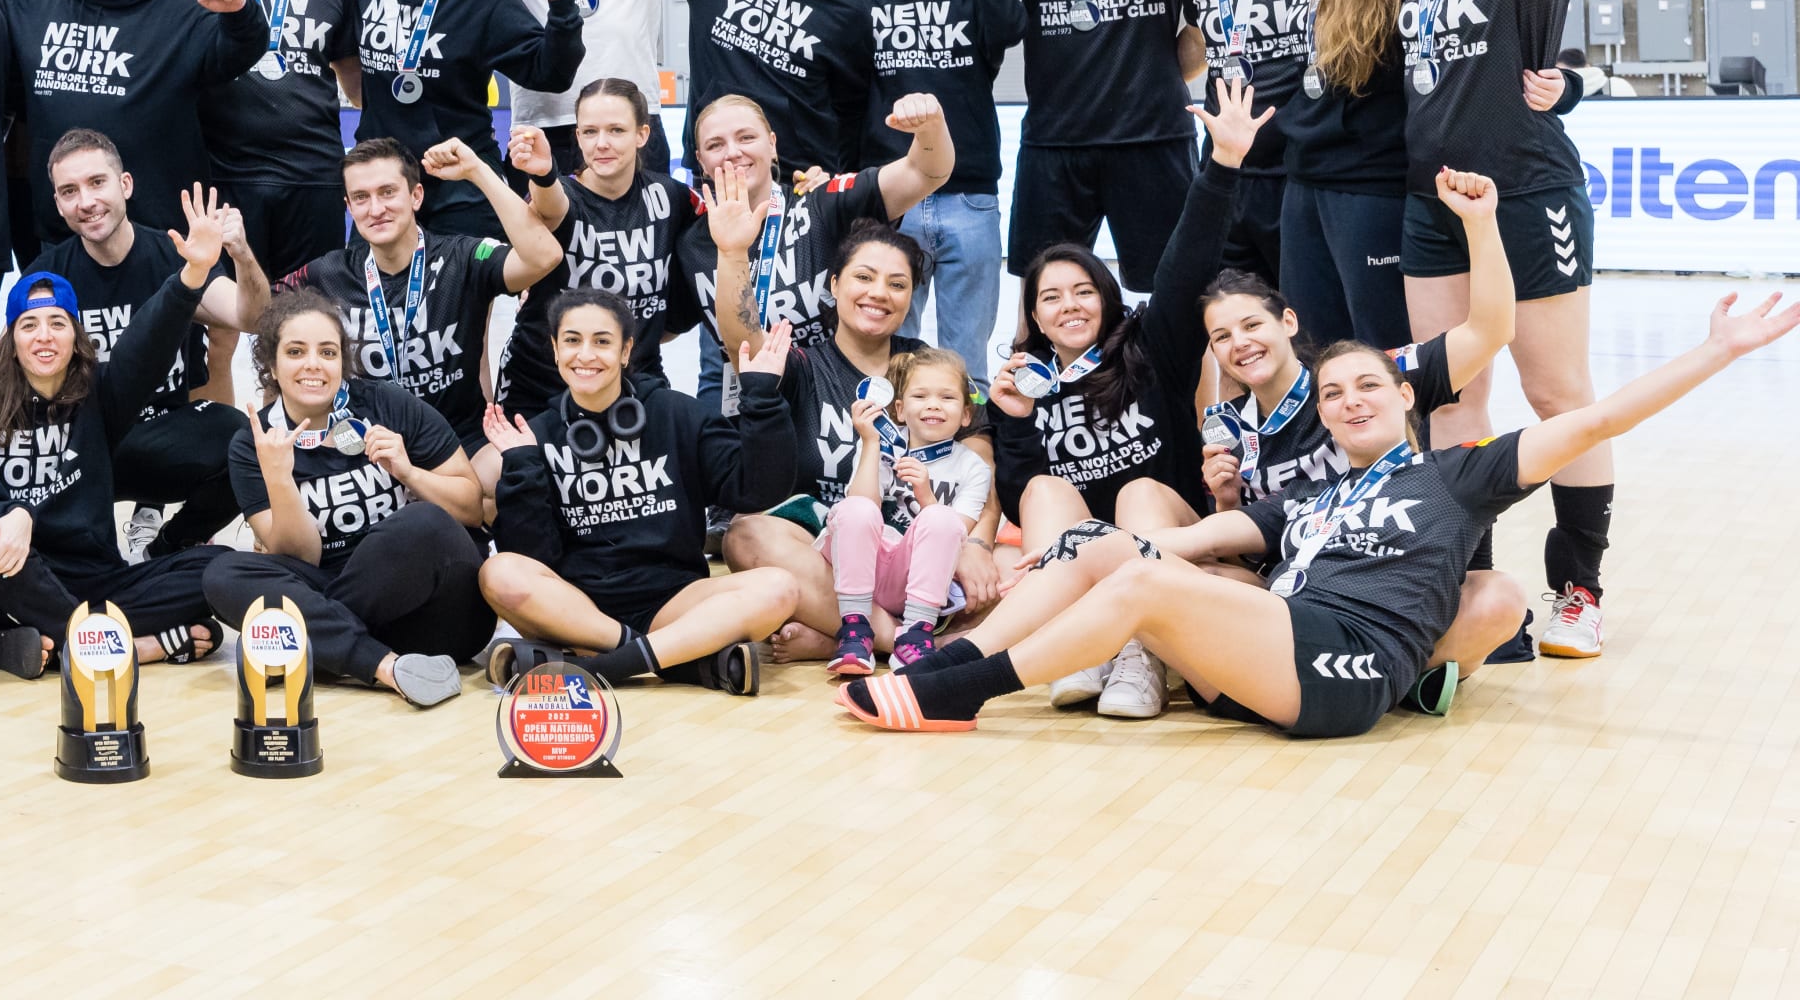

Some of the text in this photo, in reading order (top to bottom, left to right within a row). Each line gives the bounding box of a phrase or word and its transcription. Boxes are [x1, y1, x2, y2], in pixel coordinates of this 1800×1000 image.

[871, 1, 950, 28] NEW
[1040, 2, 1068, 13] THE
[1127, 2, 1165, 18] CLUB
[43, 22, 119, 49] NEW
[714, 17, 790, 62] THE WORLD'S
[873, 21, 972, 50] YORK
[1042, 28, 1056, 36] since
[1232, 32, 1240, 46] USA
[712, 25, 807, 78] HANDBALL CLUB
[874, 50, 952, 60] THE WORLD'S
[1444, 40, 1488, 61] CLUB
[40, 45, 134, 77] YORK
[939, 56, 973, 69] CLUB
[36, 70, 107, 85] THE WORLD'S
[35, 80, 126, 96] HANDBALL CLUB
[642, 182, 670, 221] 10
[568, 220, 655, 264] NEW
[565, 253, 672, 296] YORK
[429, 368, 464, 394] CLUB
[1041, 400, 1154, 462] YORK
[300, 438, 316, 447] USA
[1078, 440, 1144, 468] WORLD'S
[51, 469, 81, 494] CLUB
[300, 462, 392, 509] NEW
[553, 454, 673, 505] YORK
[561, 494, 656, 517] THE WORLD'S
[641, 500, 677, 517] CLUB
[577, 528, 592, 536] 1973
[331, 541, 346, 549] 1973
[78, 631, 105, 645] USA
[252, 625, 279, 639] USA
[527, 674, 566, 694] USA
[524, 724, 593, 732] OPEN NATIONAL
[523, 734, 595, 743] CHAMPIONSHIPS
